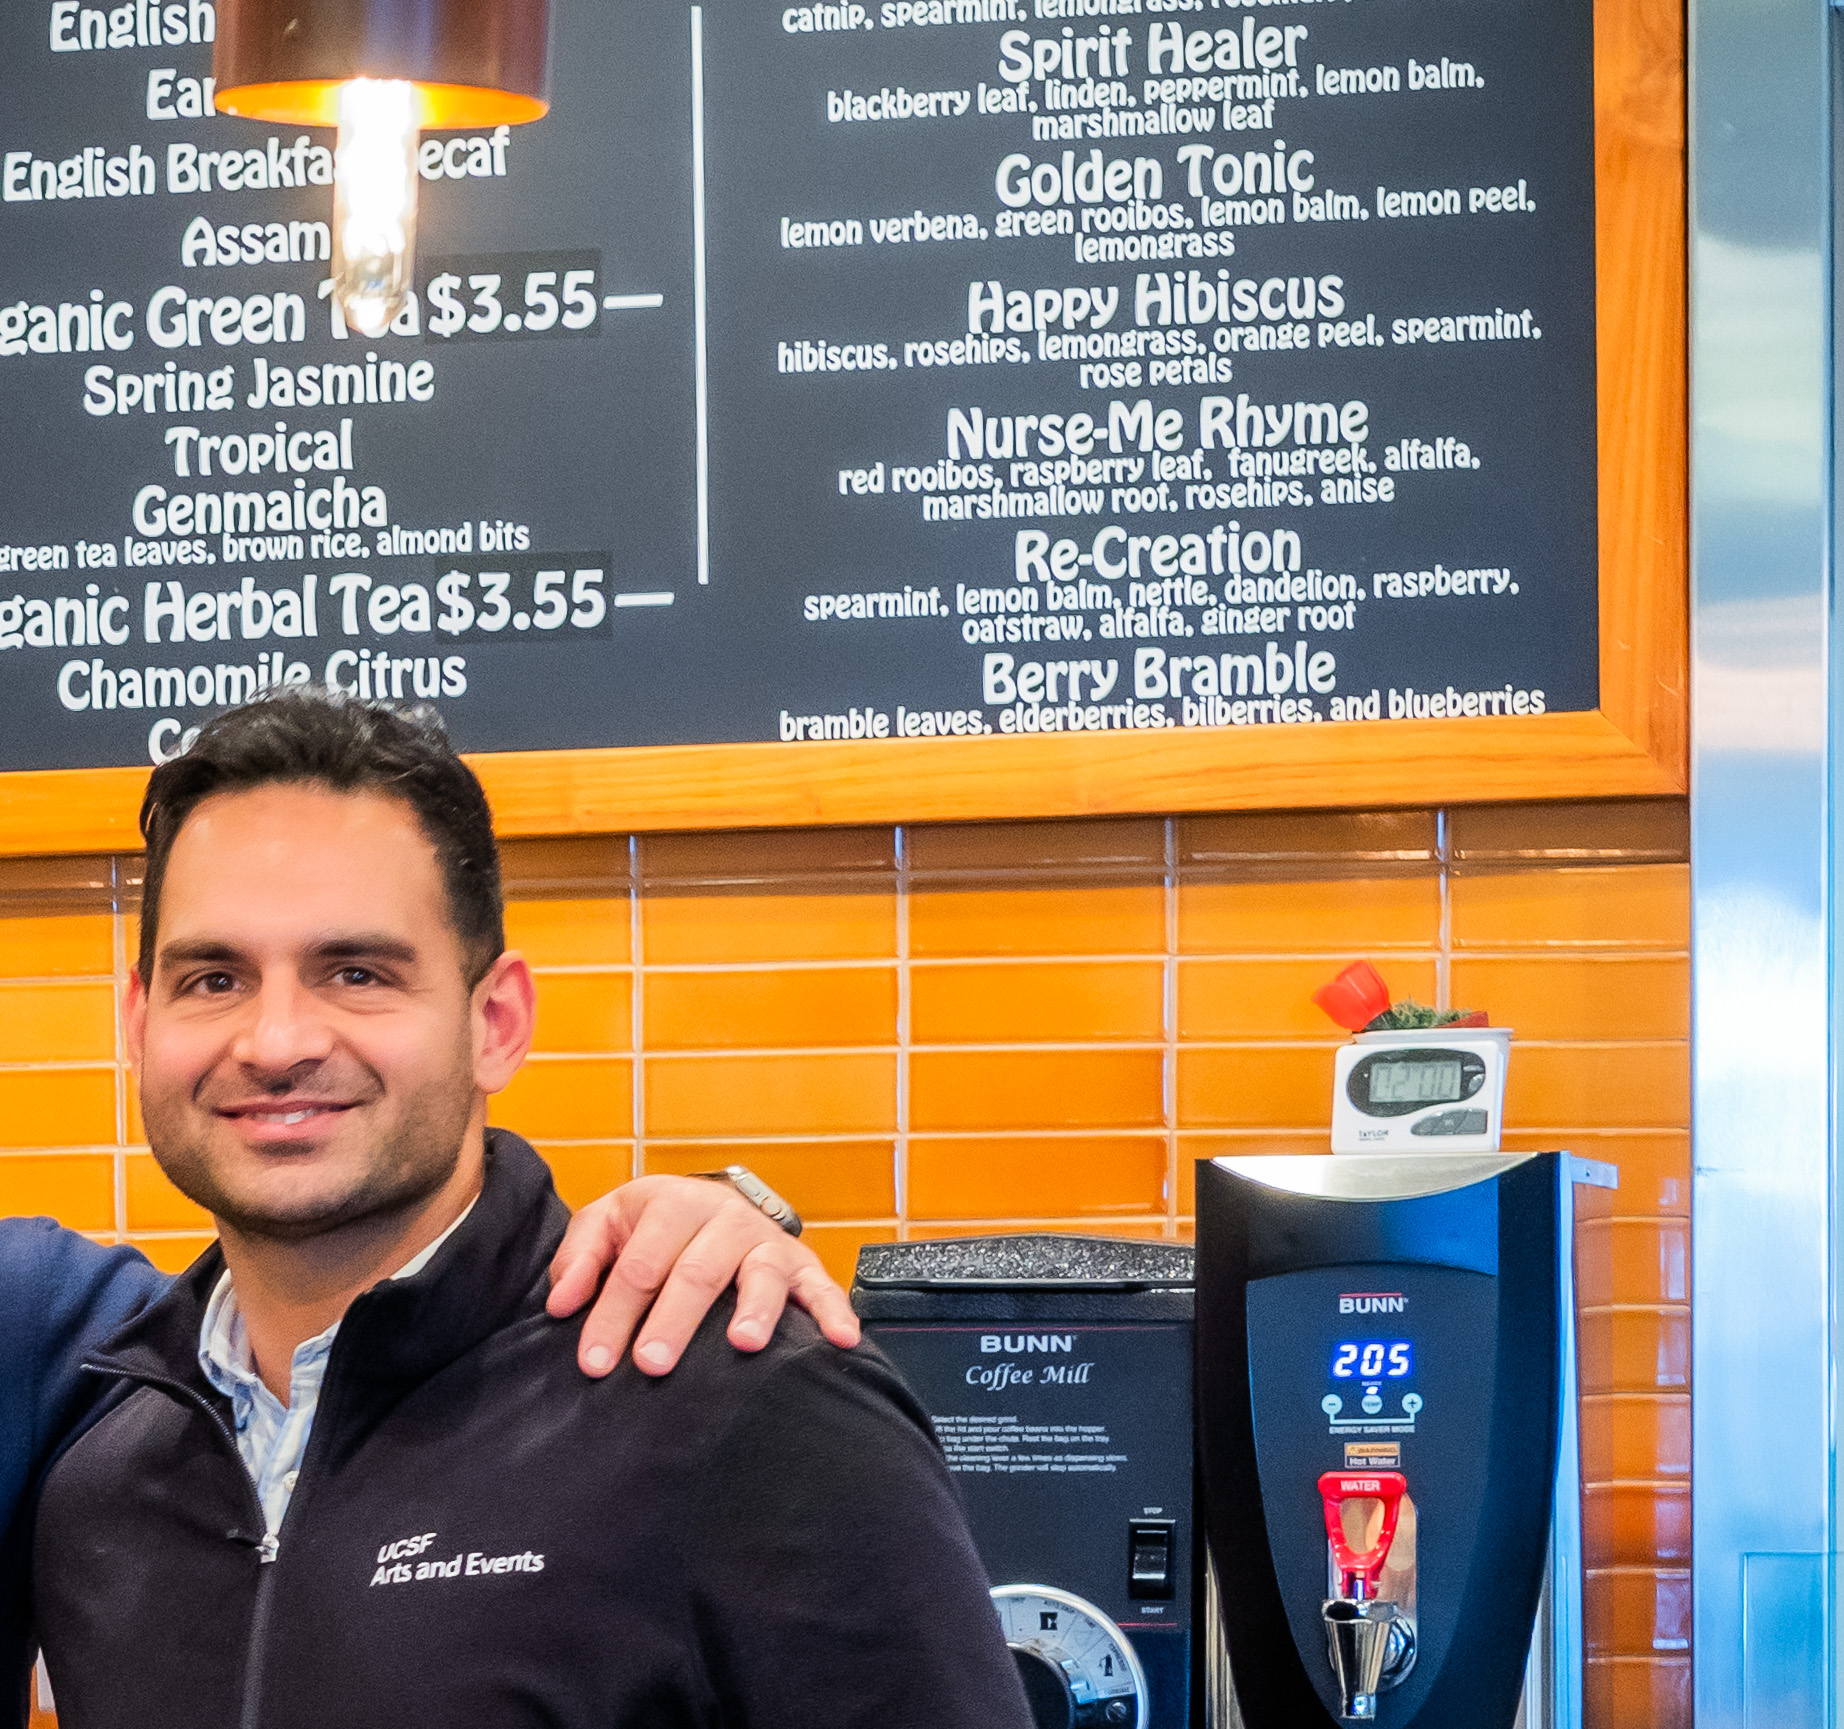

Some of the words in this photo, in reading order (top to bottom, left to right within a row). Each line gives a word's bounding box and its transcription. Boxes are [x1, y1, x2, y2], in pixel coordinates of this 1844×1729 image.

[998, 24, 1132, 83] Spirit
[1148, 15, 1308, 74] Healer
[827, 87, 970, 122] blackberry
[1315, 64, 1400, 96] lemon
[1032, 102, 1215, 141] marshmallow
[1223, 98, 1275, 131] leaf
[3, 143, 155, 203] English
[167, 134, 335, 194] Breakfa
[417, 125, 510, 180] ecaf
[995, 148, 1163, 208] Golden
[1177, 139, 1314, 197] Tonic
[182, 215, 331, 267] Assam
[147, 285, 306, 346] Green
[428, 270, 597, 339] $3.55
[967, 280, 1119, 334] Happy
[1135, 269, 1345, 327] Hibiscus
[83, 364, 234, 418] Spring
[247, 354, 435, 409] Jasmine
[165, 418, 354, 478] Tropical
[947, 399, 1184, 460] Nurse-Me
[1200, 393, 1369, 448] Rhyme
[132, 475, 389, 538] Genmaicha
[74, 538, 117, 568] tea
[223, 531, 304, 564] brown
[377, 523, 473, 556] almond
[480, 520, 529, 553] bits
[1015, 521, 1302, 583] Re-Creation
[142, 575, 317, 643] Herbal
[329, 574, 432, 637] Tea
[436, 568, 607, 635] $3.55
[57, 651, 309, 712] Chamomile
[324, 650, 467, 702] Citrus
[983, 652, 1118, 705] Berry
[1135, 640, 1336, 699] Bramble
[965, 1362, 1034, 1391] Coffee
[1039, 1362, 1095, 1384] Mill
[1333, 1343, 1410, 1377] 205
[1341, 1480, 1381, 1491] WATER
[1369, 1457, 1396, 1466] Water
[369, 1563, 412, 1586] Arts
[415, 1553, 463, 1580] and
[464, 1551, 545, 1576] Events
[377, 1532, 437, 1563] UCSF
